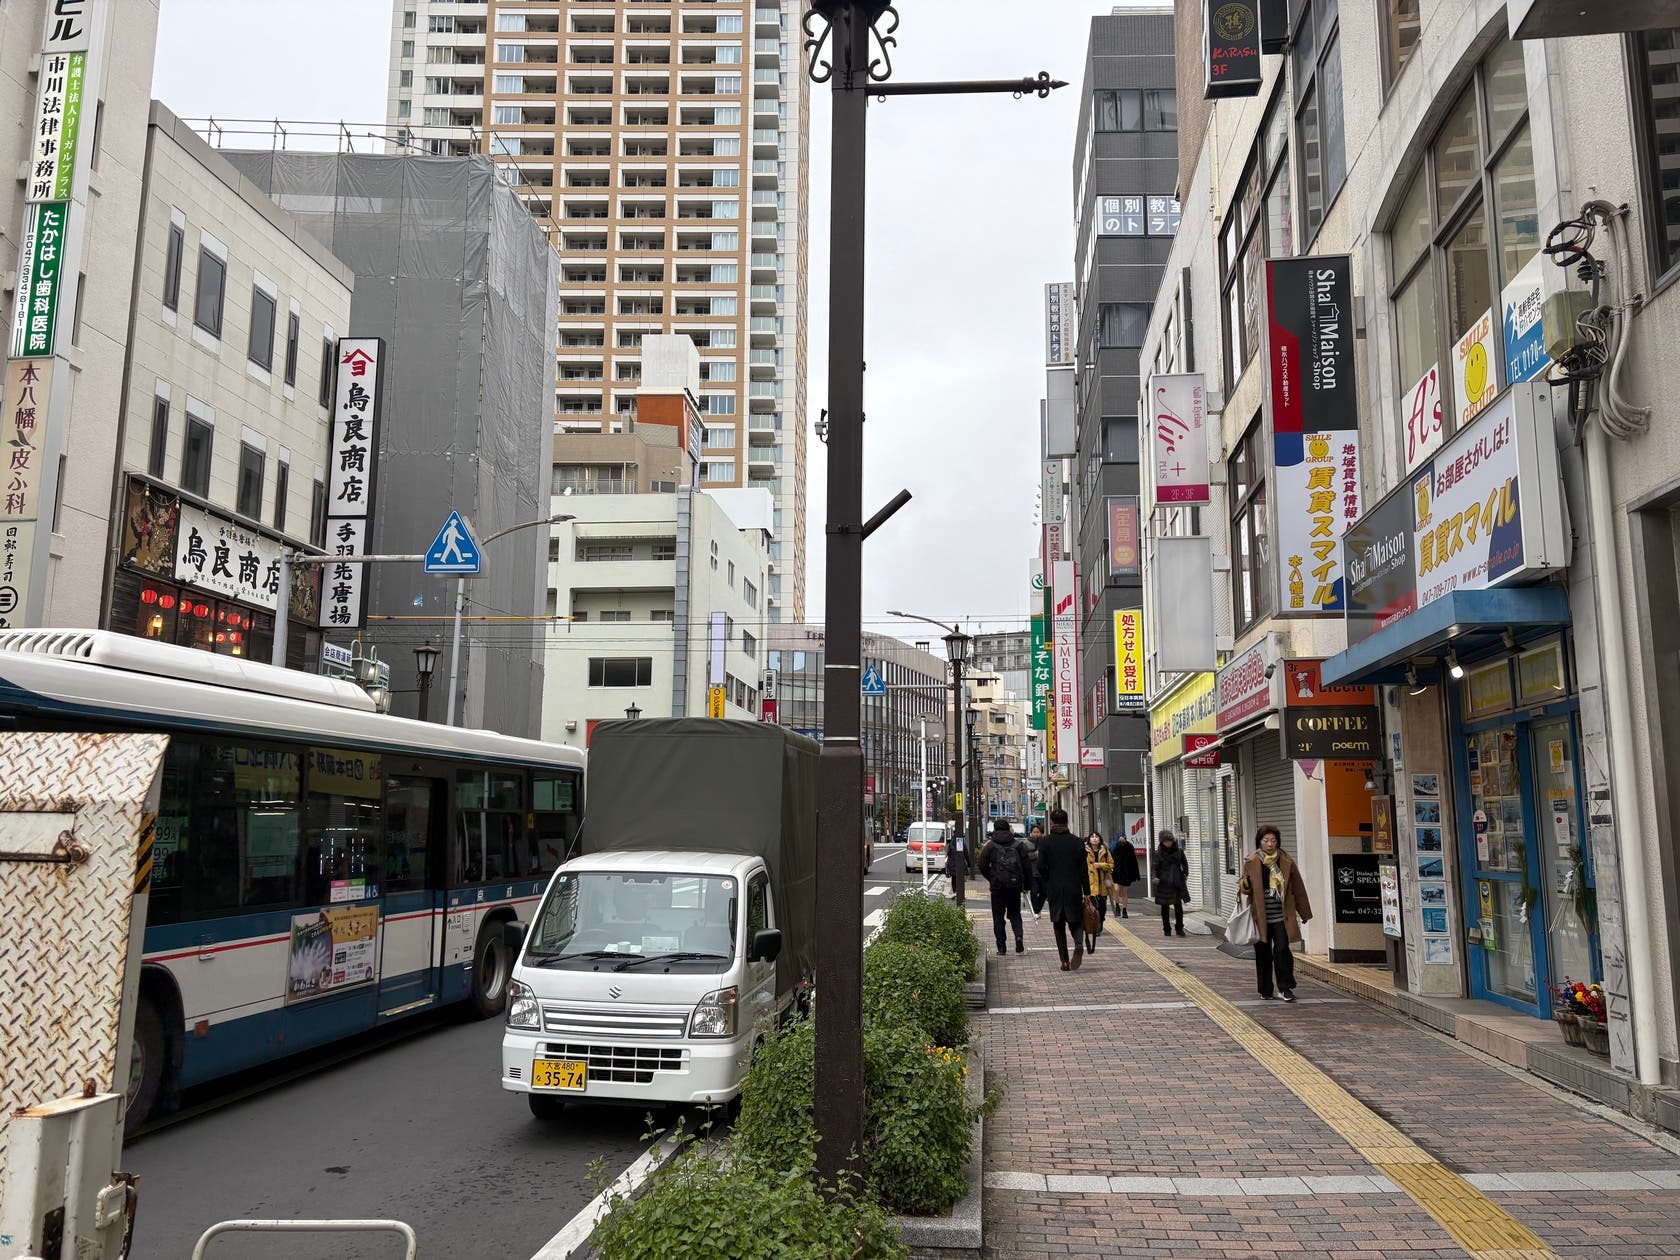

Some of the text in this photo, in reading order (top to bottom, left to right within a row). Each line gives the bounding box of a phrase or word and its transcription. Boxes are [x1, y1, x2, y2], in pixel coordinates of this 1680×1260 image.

[32, 57, 67, 199] 市川法律事務所
[58, 54, 83, 198] 弁護士法人リーガルプラス
[29, 210, 60, 350] たかはし歯科医院
[1312, 361, 1321, 390] Shop
[1459, 316, 1490, 361] SMILE
[1511, 356, 1522, 382] TEL
[5, 361, 40, 515] 本八幡 皮ふ科
[338, 381, 371, 504] 鳥良商店
[182, 526, 281, 595] 鳥良商店
[1306, 466, 1337, 605] 賃貸スマイル
[1418, 476, 1517, 577] 賃貸スマイル
[329, 522, 357, 625] 手羽先唐揚
[1288, 555, 1305, 609] 本八幡店
[1059, 634, 1073, 730] SMBC日興証券
[1121, 614, 1138, 691] 処方せん受付
[1296, 716, 1368, 731] COFFEE
[1298, 742, 1313, 752] 2F
[544, 1071, 583, 1088] 35-74
